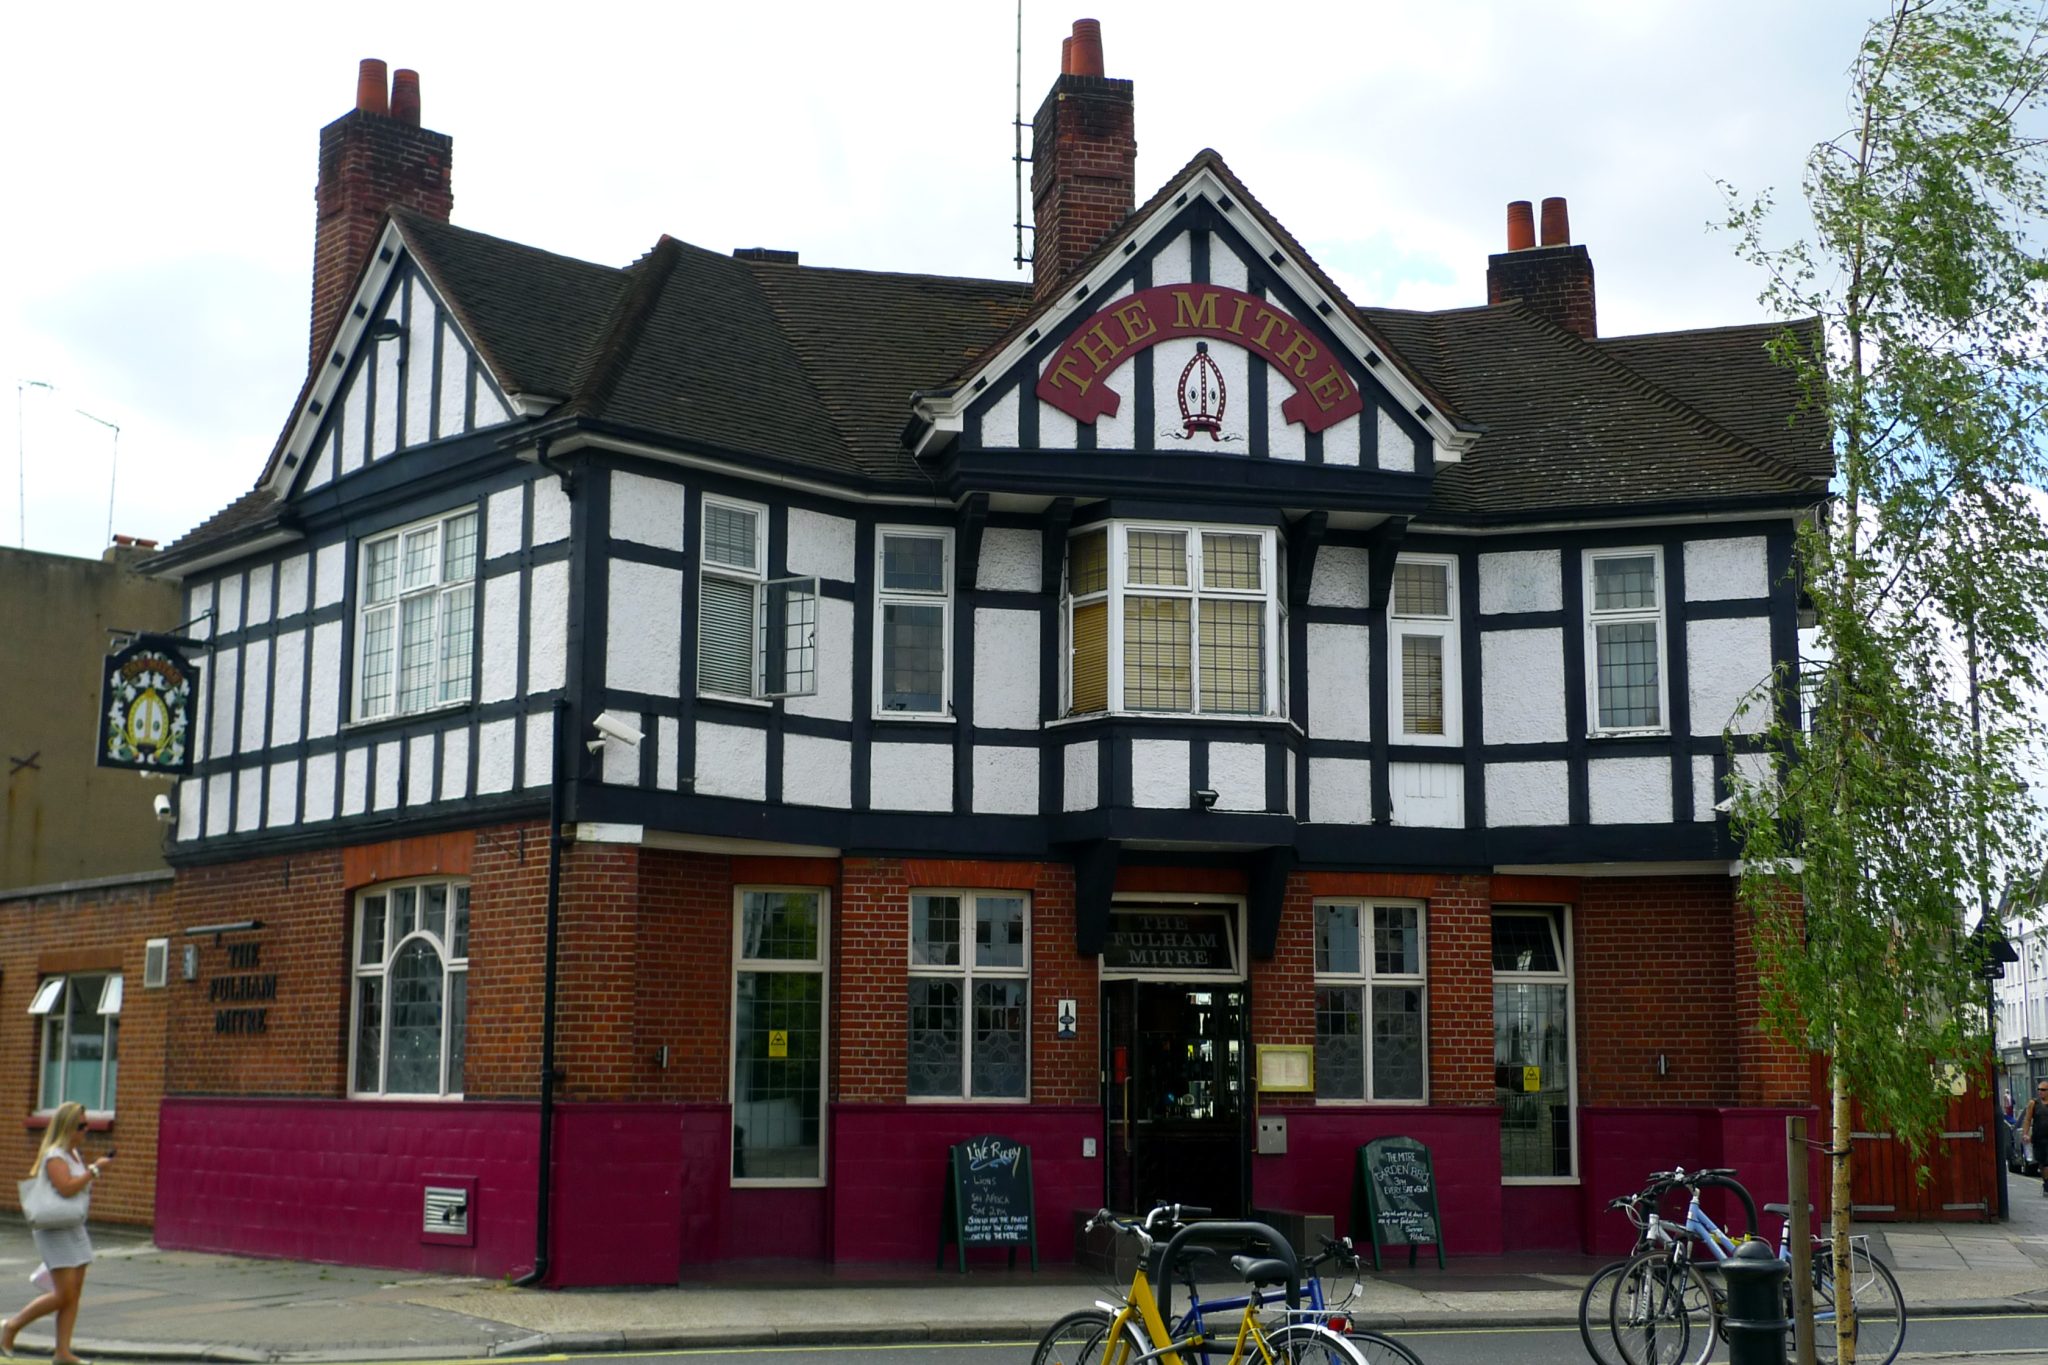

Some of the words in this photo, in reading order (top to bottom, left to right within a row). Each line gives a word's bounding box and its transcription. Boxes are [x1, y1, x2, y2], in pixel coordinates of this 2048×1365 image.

[1051, 299, 1158, 397] THE
[1171, 291, 1352, 412] MITRE
[1138, 915, 1189, 930] THE
[1112, 932, 1219, 948] FULHAM
[227, 943, 260, 969] THE
[1128, 949, 1209, 965] MITRE
[208, 974, 277, 1003] FULHAM
[215, 1008, 267, 1034] MITRE
[1385, 1152, 1398, 1163] THE
[1398, 1152, 1416, 1162] MITRE
